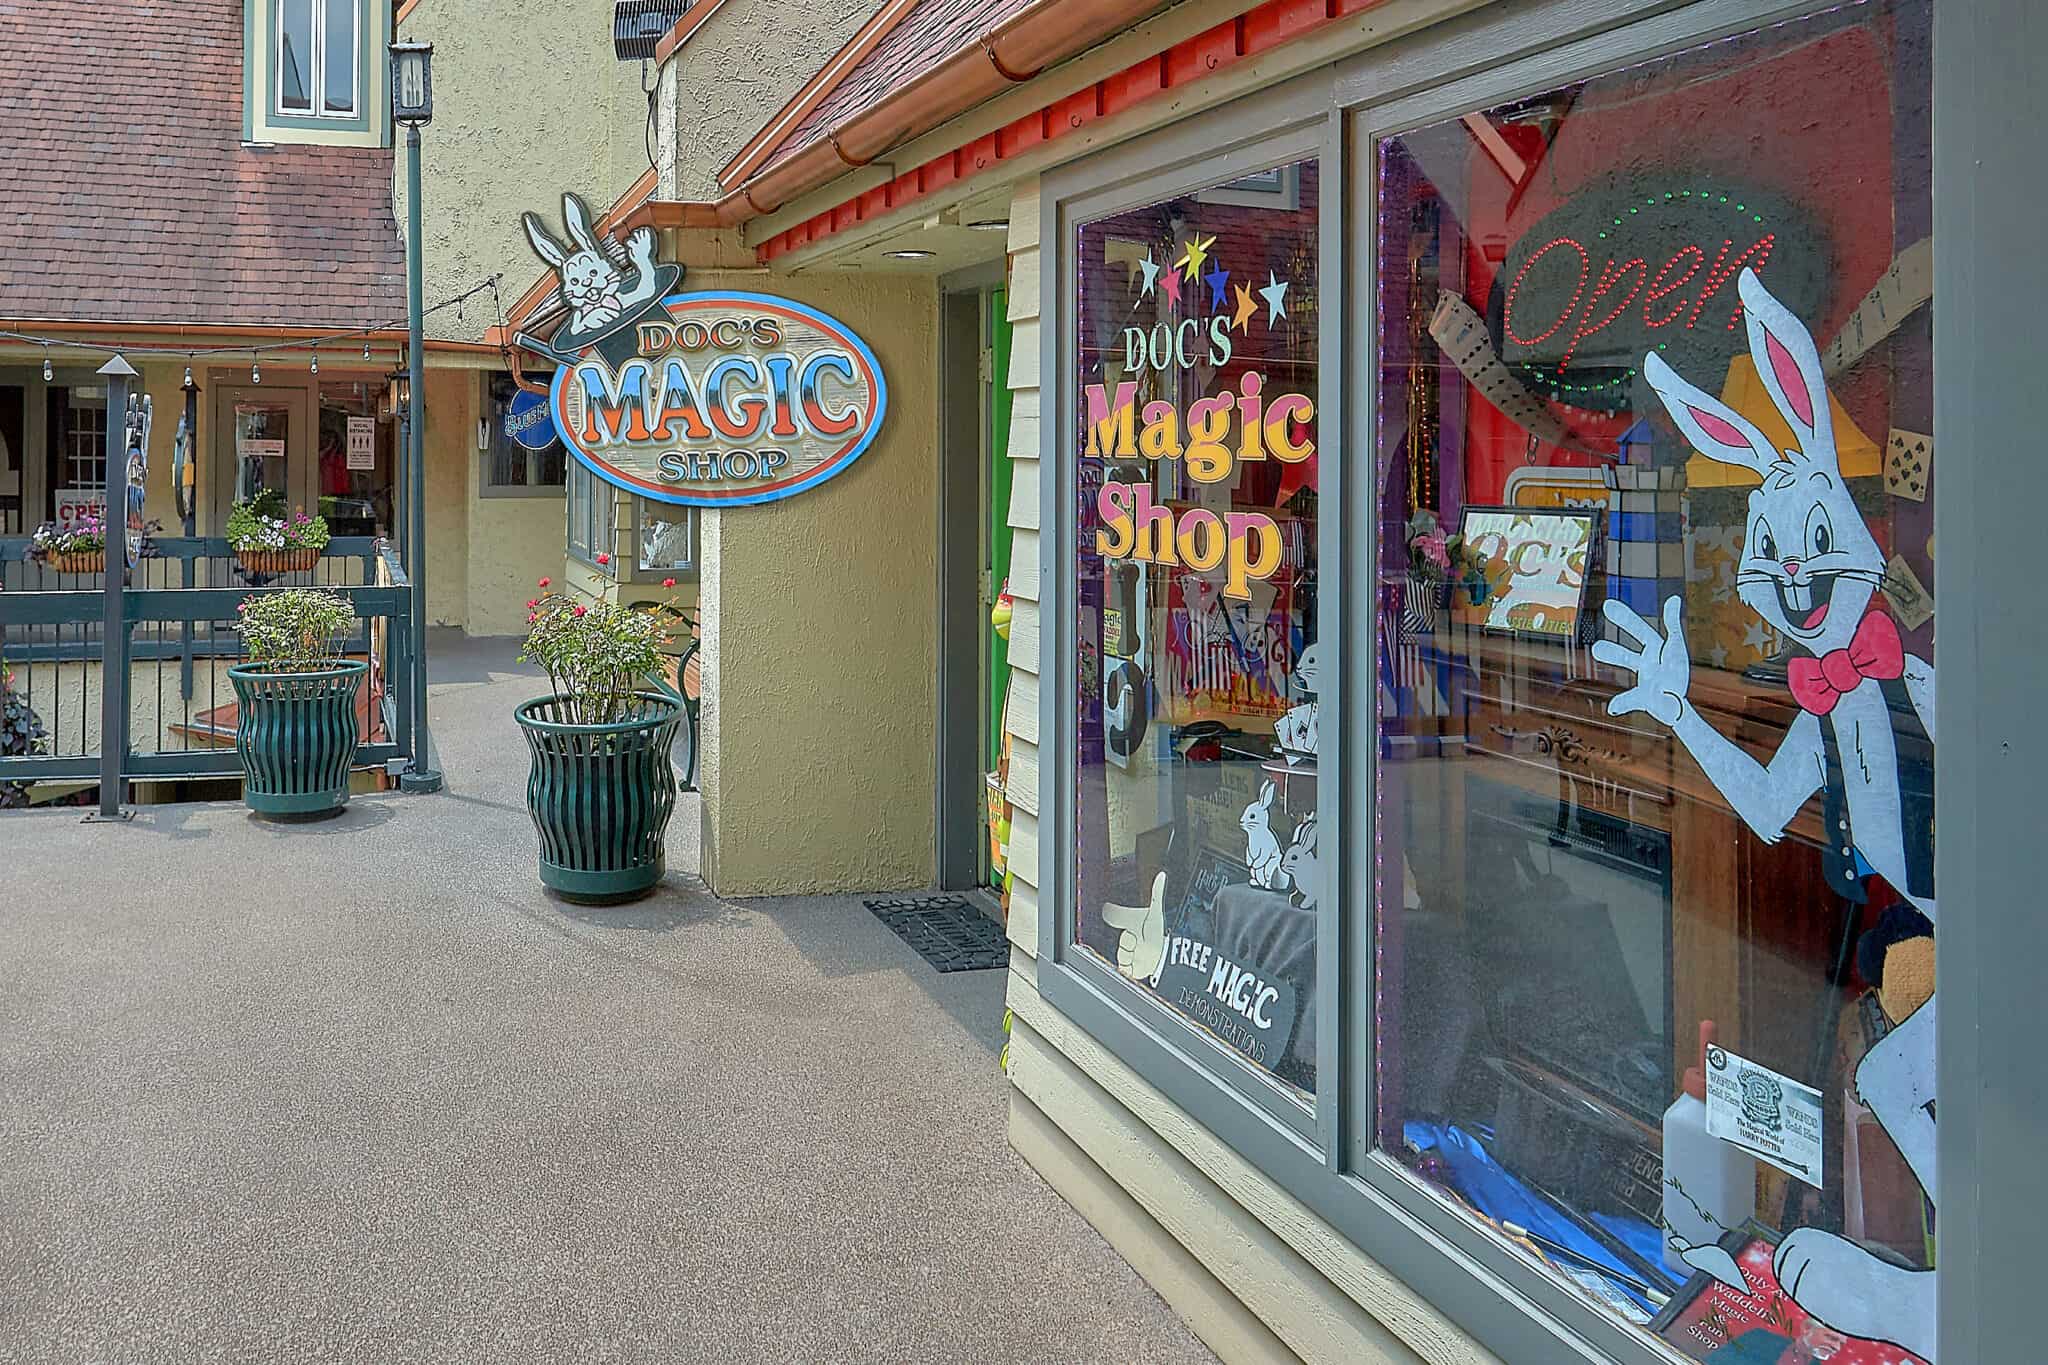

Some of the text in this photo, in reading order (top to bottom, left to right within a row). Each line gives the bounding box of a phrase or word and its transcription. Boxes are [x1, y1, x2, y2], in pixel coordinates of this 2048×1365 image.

[640, 318, 782, 353] DOC'S
[1504, 232, 1776, 374] Open
[1123, 314, 1234, 373] DOC'S
[577, 354, 863, 444] MAGIC
[1084, 370, 1317, 484] Magic
[656, 448, 790, 482] SHOP
[59, 504, 106, 522] OPE
[1096, 481, 1283, 601] Shop
[1170, 936, 1279, 1029] FREE MAGIC
[1178, 985, 1267, 1064] DEMONSTRATIONS
[1687, 1325, 1719, 1350] Shop
[1710, 1296, 1750, 1324] Magic
